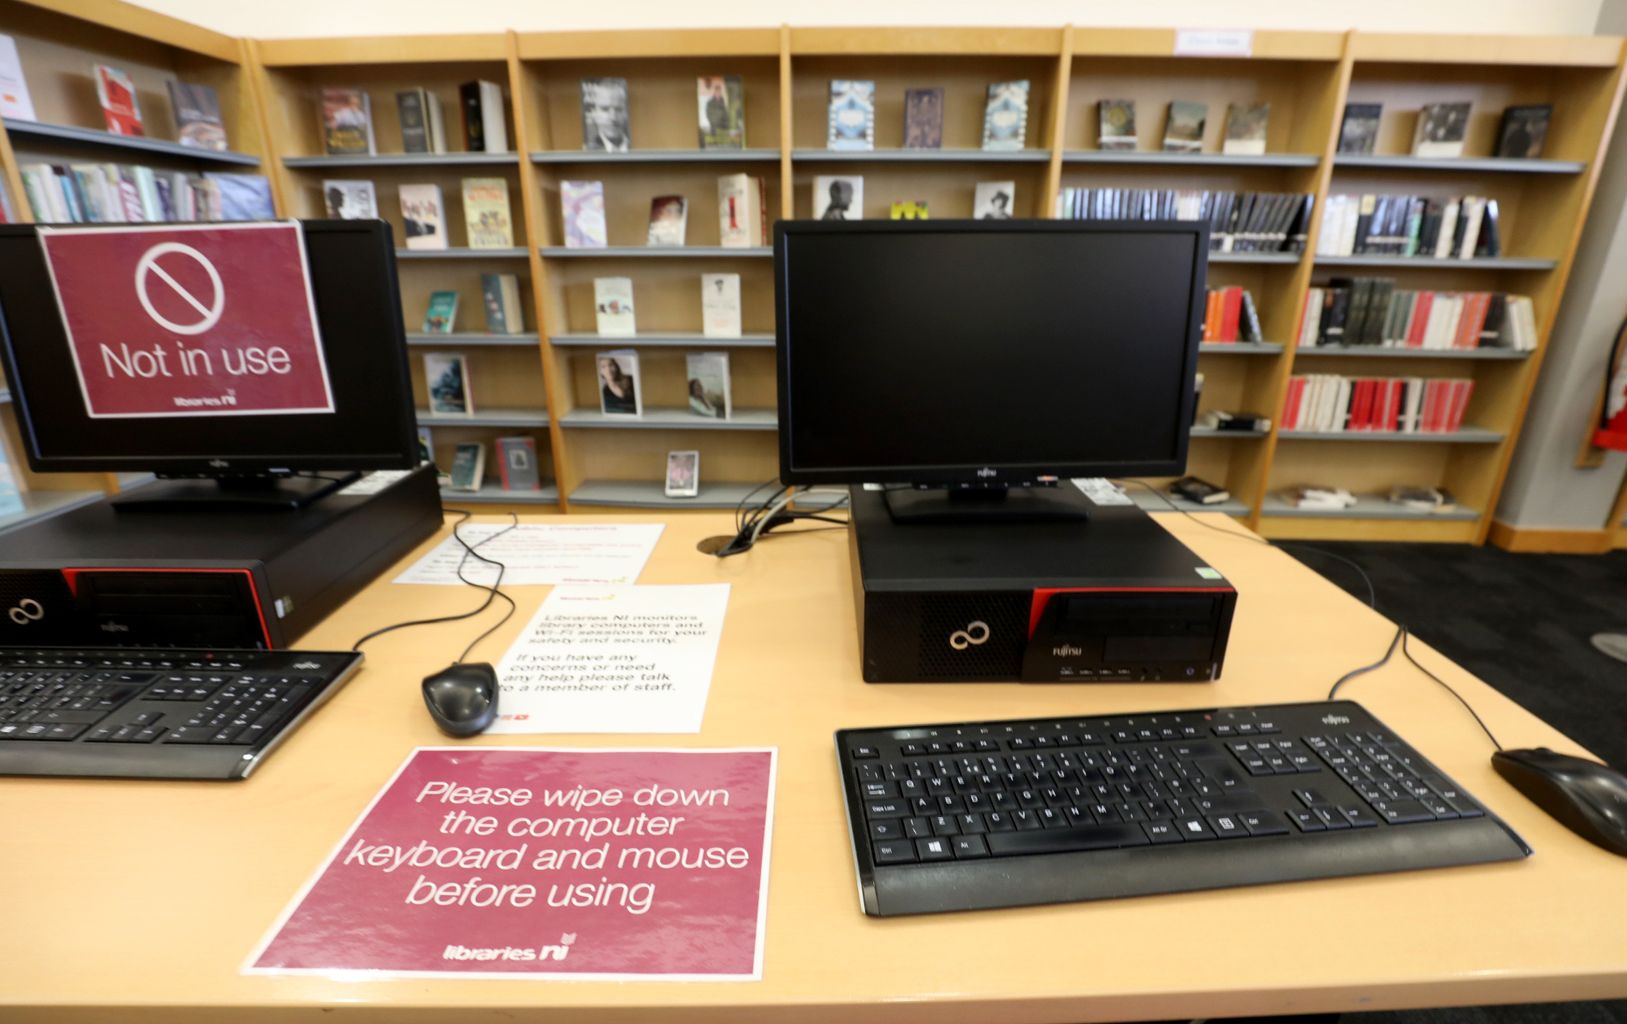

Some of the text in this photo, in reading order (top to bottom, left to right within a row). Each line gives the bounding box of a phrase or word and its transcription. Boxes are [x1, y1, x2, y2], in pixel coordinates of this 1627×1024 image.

[100, 340, 291, 378] Not in use
[590, 622, 671, 630] computers
[1053, 644, 1082, 658] FUJITSU
[566, 654, 604, 662] have
[510, 664, 587, 672] concerns
[503, 673, 670, 682] any help please talk
[534, 684, 606, 692] member
[612, 683, 629, 691] of
[634, 683, 676, 692] staff.
[1008, 773, 1014, 781] T
[1057, 770, 1065, 778] U
[906, 780, 915, 788] Q
[931, 778, 941, 786] W
[1047, 789, 1056, 797] H
[1098, 785, 1107, 793] K
[415, 781, 730, 813] Please wipe down
[970, 794, 978, 803] D
[1023, 790, 1031, 799] G
[919, 798, 927, 806] A
[1096, 805, 1106, 813] M
[965, 815, 973, 823] X
[1018, 811, 1025, 819] V
[439, 809, 685, 842] the computer
[343, 839, 750, 873] keyboard and mouse
[405, 874, 656, 915] before using
[442, 944, 536, 961] libraries
